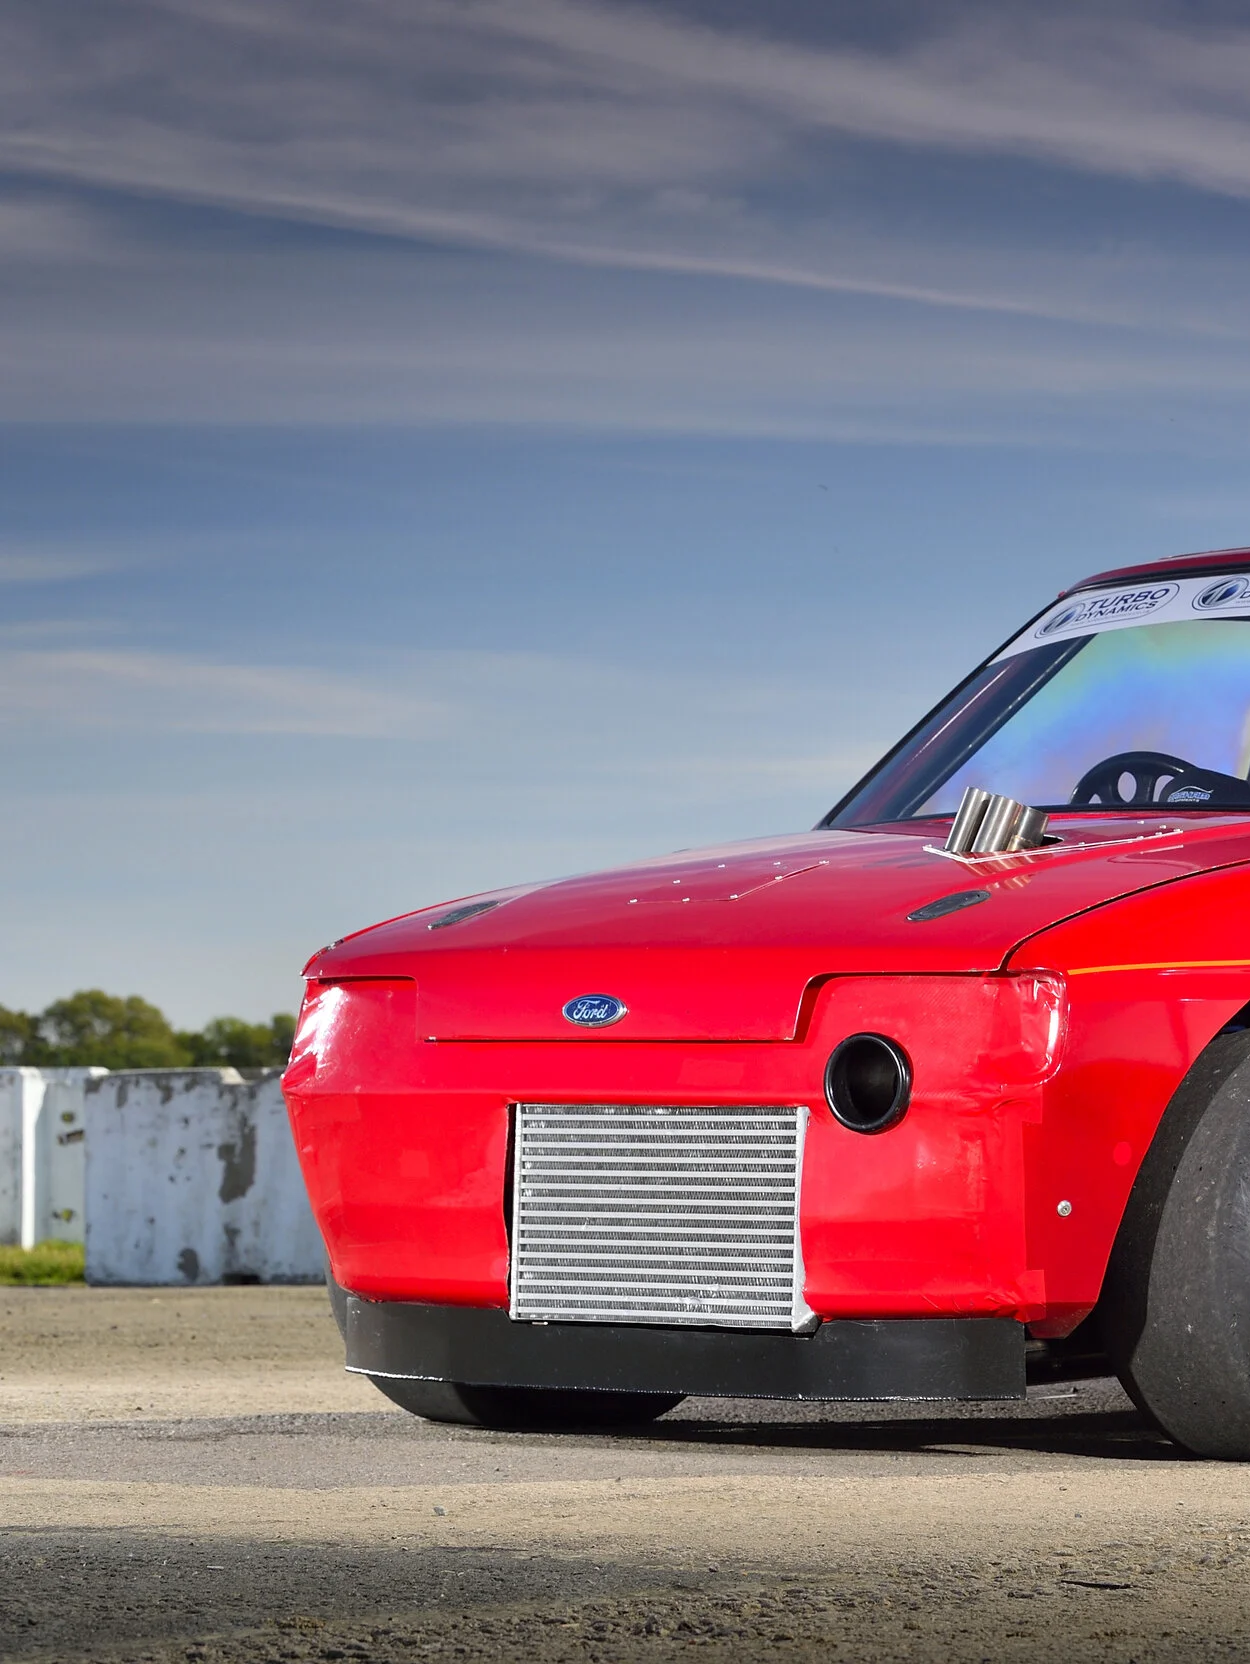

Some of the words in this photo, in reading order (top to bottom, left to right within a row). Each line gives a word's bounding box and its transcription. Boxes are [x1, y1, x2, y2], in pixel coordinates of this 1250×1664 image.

[1087, 588, 1170, 611] TURBO
[1074, 601, 1158, 622] DYNAMICS
[573, 999, 609, 1019] Ford
